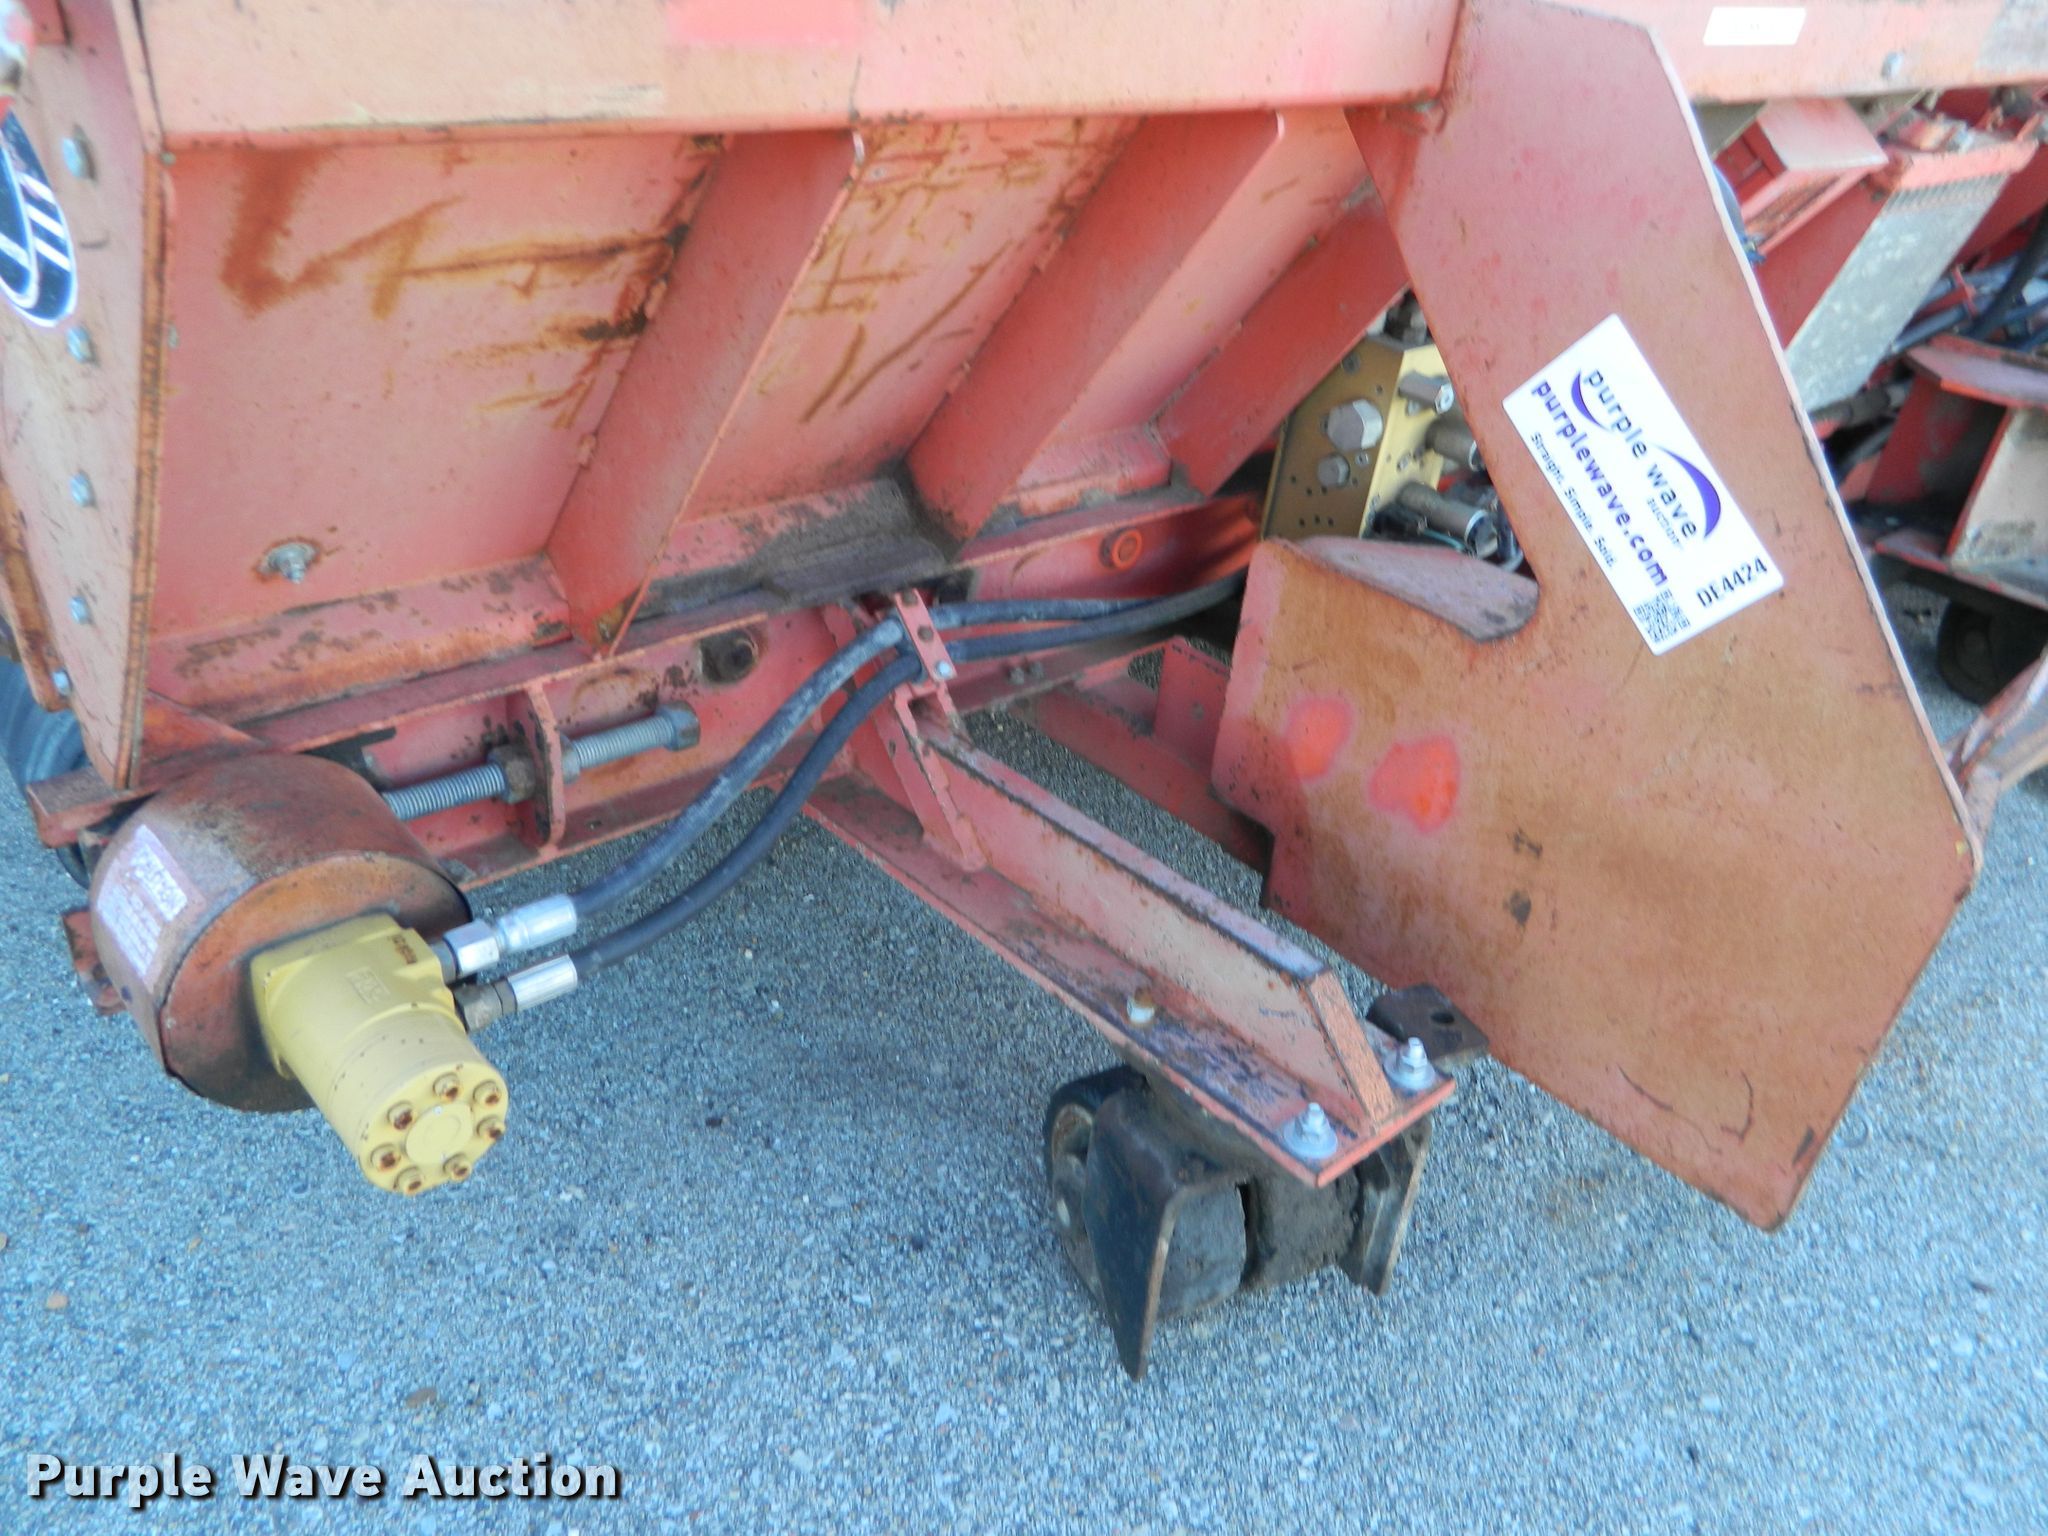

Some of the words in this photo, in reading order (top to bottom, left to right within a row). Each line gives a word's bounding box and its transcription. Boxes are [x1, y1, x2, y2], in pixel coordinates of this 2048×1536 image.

[1531, 380, 1668, 587] purplewave.com
[1583, 369, 1648, 459] purple
[1647, 464, 1697, 538] wave
[1695, 557, 1769, 608] DE4424
